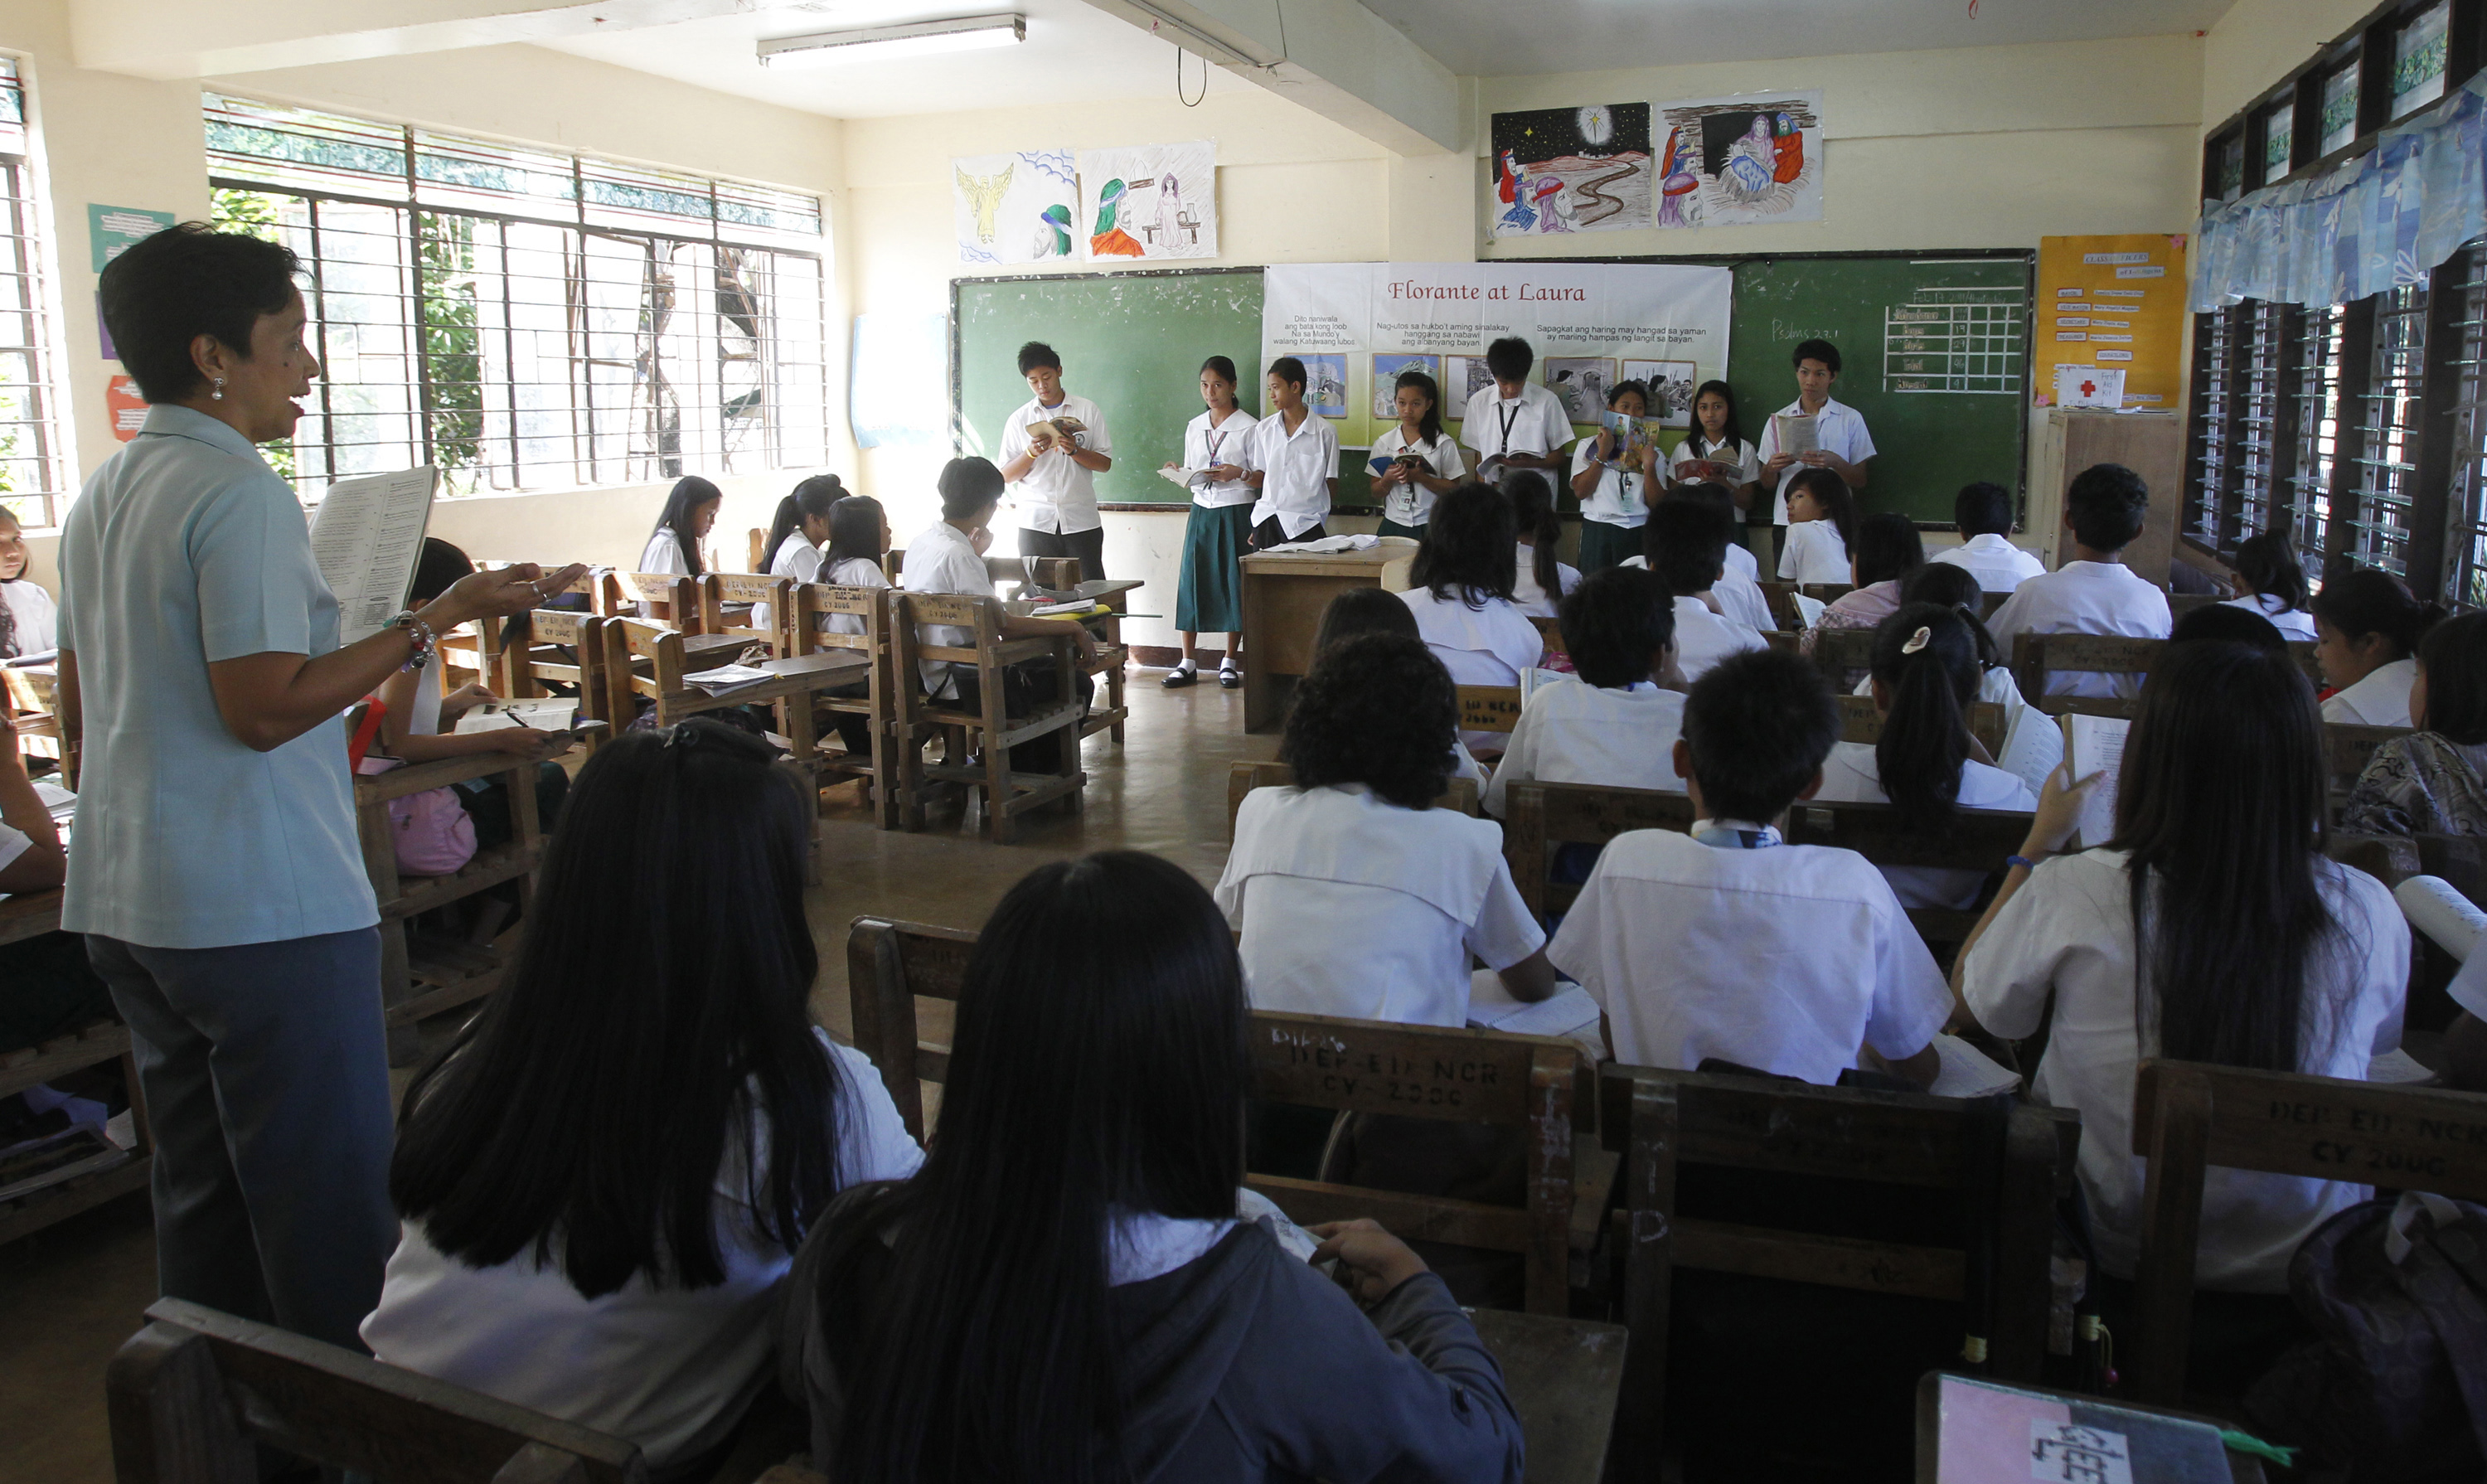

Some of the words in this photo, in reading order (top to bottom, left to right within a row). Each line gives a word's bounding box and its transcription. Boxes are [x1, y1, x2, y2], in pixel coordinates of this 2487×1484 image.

[1388, 279, 1480, 299] Florante
[1487, 284, 1510, 300] at
[1518, 283, 1587, 301] Laura
[1315, 323, 1331, 332] kong
[1376, 323, 1409, 331] Nag-utos
[1449, 323, 1473, 332] aming
[1475, 323, 1510, 333] sinalakay
[1536, 324, 1573, 334] Sapagkat
[1575, 326, 1590, 334] ang
[1592, 325, 1616, 335] haring
[1618, 327, 1635, 335] may
[1636, 326, 1665, 336] hangad
[1680, 328, 1707, 337] yaman
[1772, 318, 1810, 342] Psalms
[1404, 330, 1441, 339] hanggang
[1589, 333, 1620, 342] hampas
[1634, 334, 1656, 343] langit
[1668, 335, 1694, 344] bayan.
[1273, 338, 1298, 347] walang
[1299, 338, 1336, 347] Katuwaang
[1417, 338, 1455, 347] abanyang
[1457, 339, 1482, 347] bayan.
[2101, 372, 2118, 381] First
[1433, 1060, 1500, 1085] NCR
